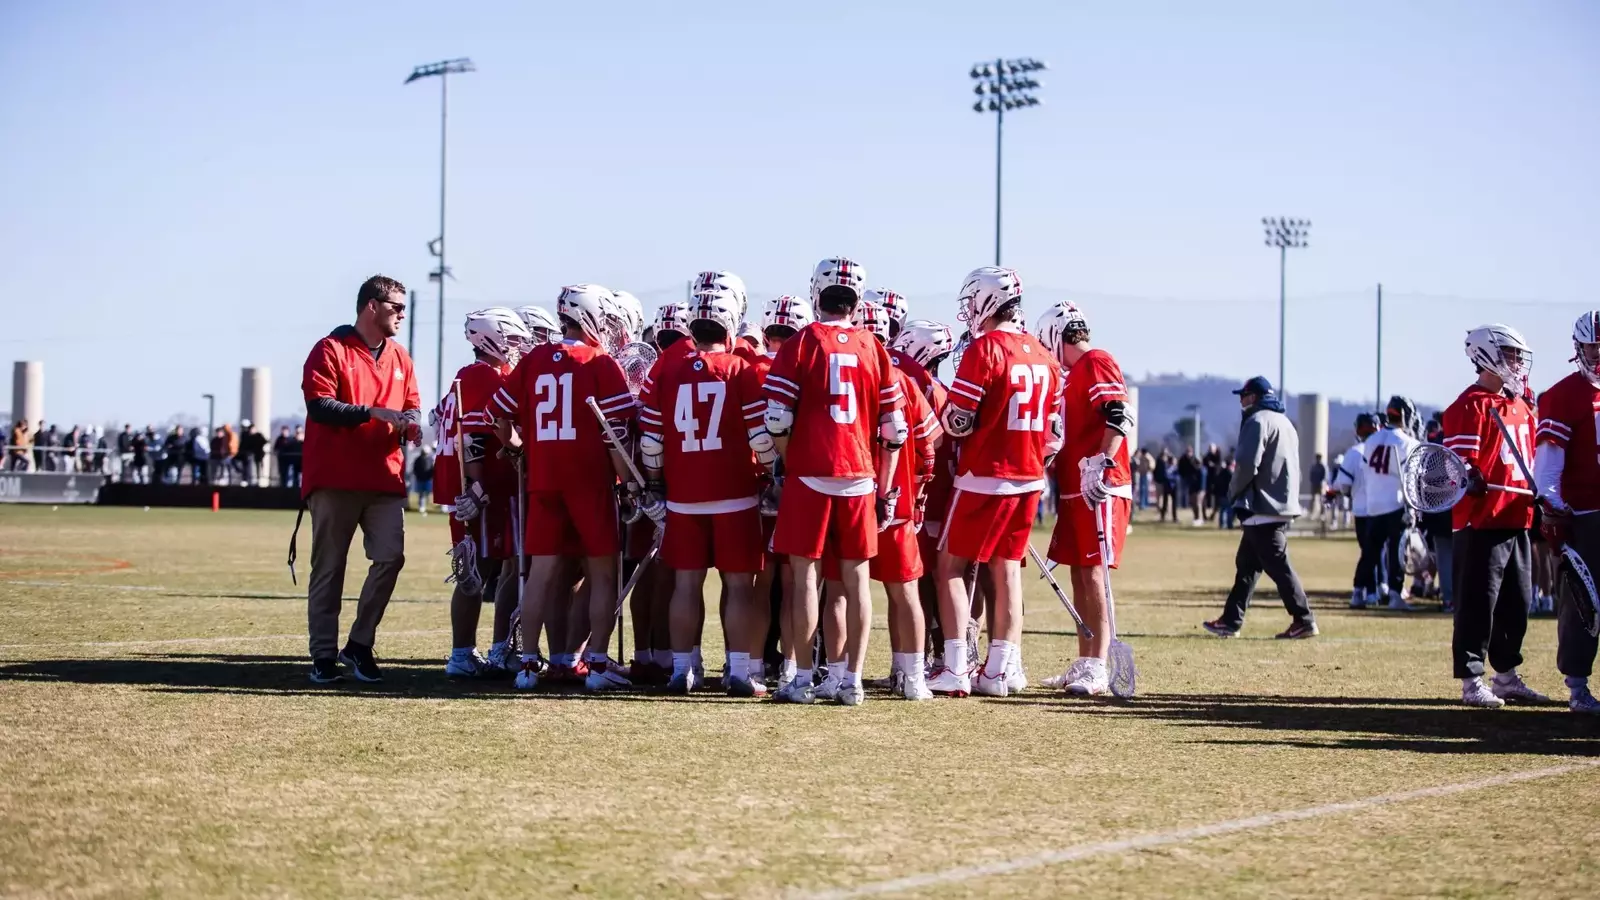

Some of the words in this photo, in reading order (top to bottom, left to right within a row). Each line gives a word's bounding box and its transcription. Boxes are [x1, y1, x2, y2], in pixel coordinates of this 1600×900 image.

[534, 372, 577, 442] 21
[673, 381, 727, 452] 47
[829, 353, 858, 424] 5
[1007, 363, 1050, 432] 27
[1368, 444, 1391, 475] 41
